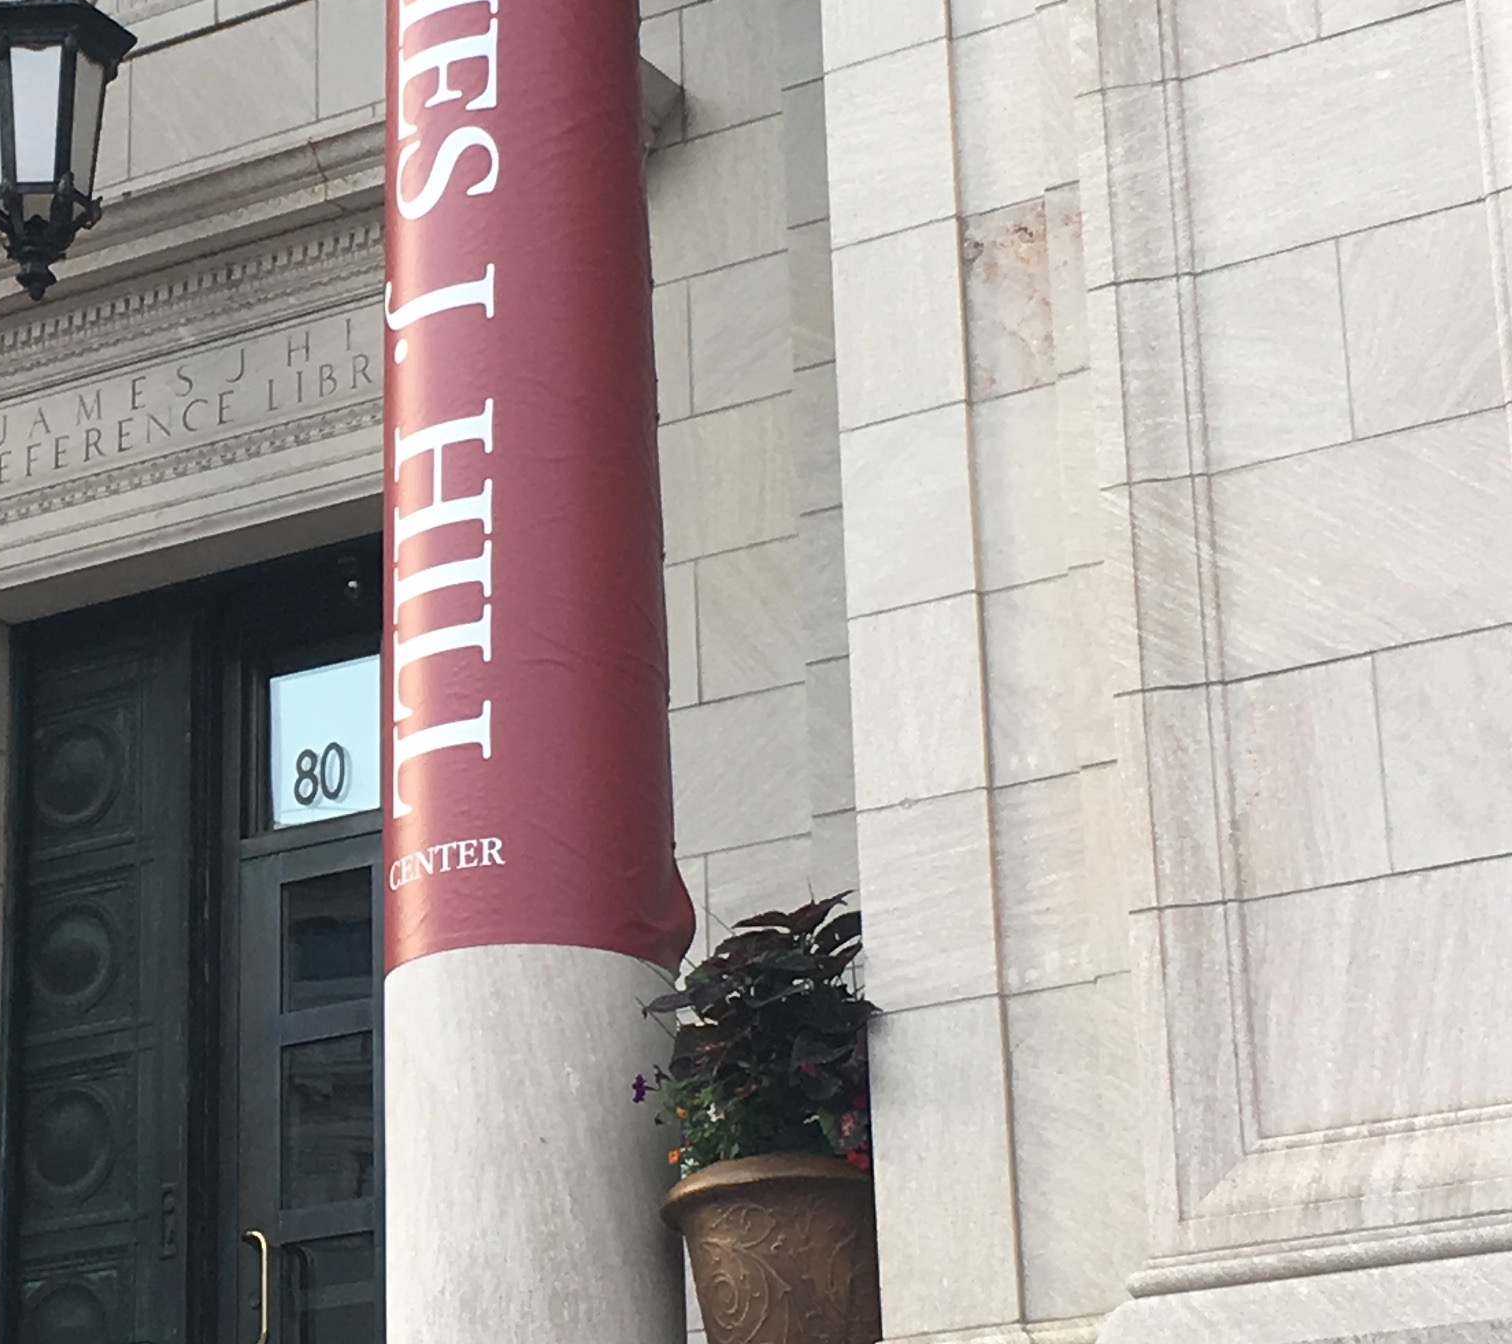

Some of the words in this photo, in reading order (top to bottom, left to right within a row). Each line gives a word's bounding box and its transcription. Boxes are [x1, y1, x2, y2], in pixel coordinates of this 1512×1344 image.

[225, 348, 246, 384] J
[392, 398, 494, 818] HILL
[294, 742, 345, 806] 80
[389, 837, 506, 891] CENTER
